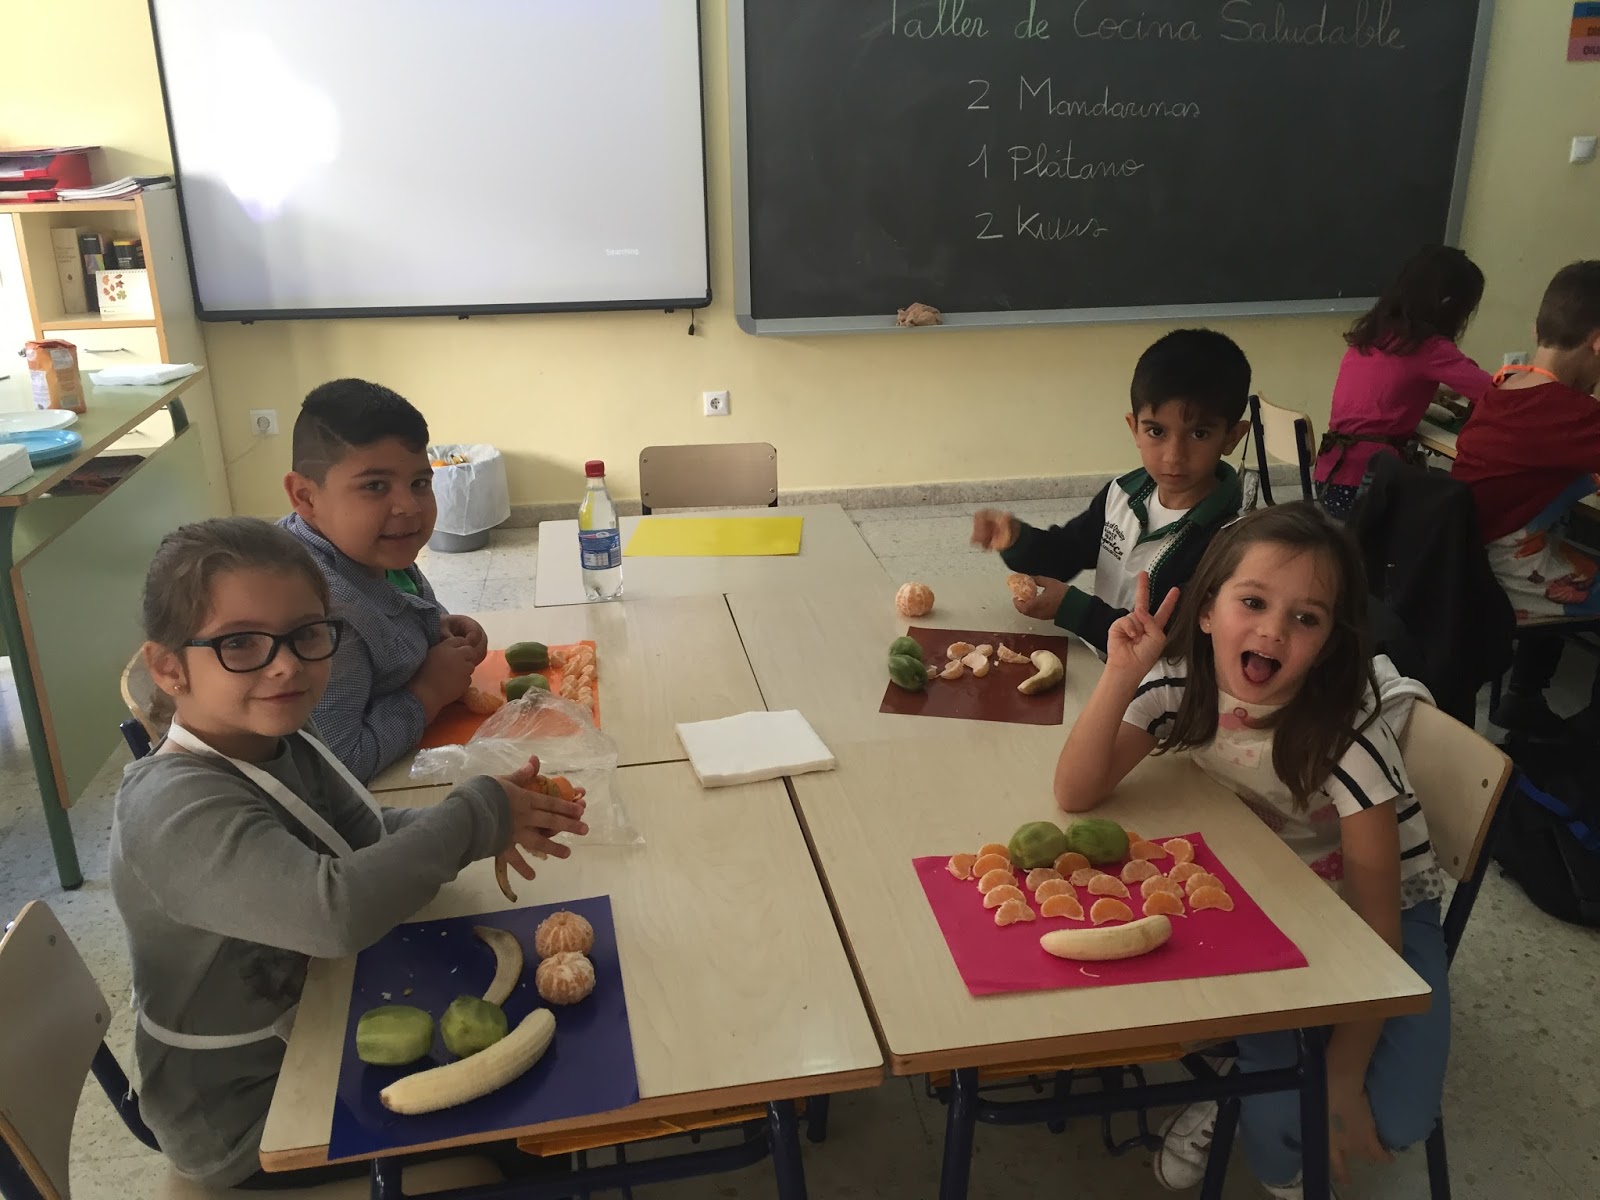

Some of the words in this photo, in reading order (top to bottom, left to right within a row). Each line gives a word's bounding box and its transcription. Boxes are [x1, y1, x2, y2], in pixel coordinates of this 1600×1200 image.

[1014, 0, 1050, 39] de
[1073, 0, 1201, 41] Cocina
[1219, 0, 1406, 48] Saludable
[967, 79, 990, 110] 2
[1018, 75, 1201, 119] Mandarinas
[967, 143, 988, 179] 1
[1007, 139, 1145, 181] Plátano
[975, 211, 1004, 240] 2
[1016, 204, 1109, 241] Kiwis
